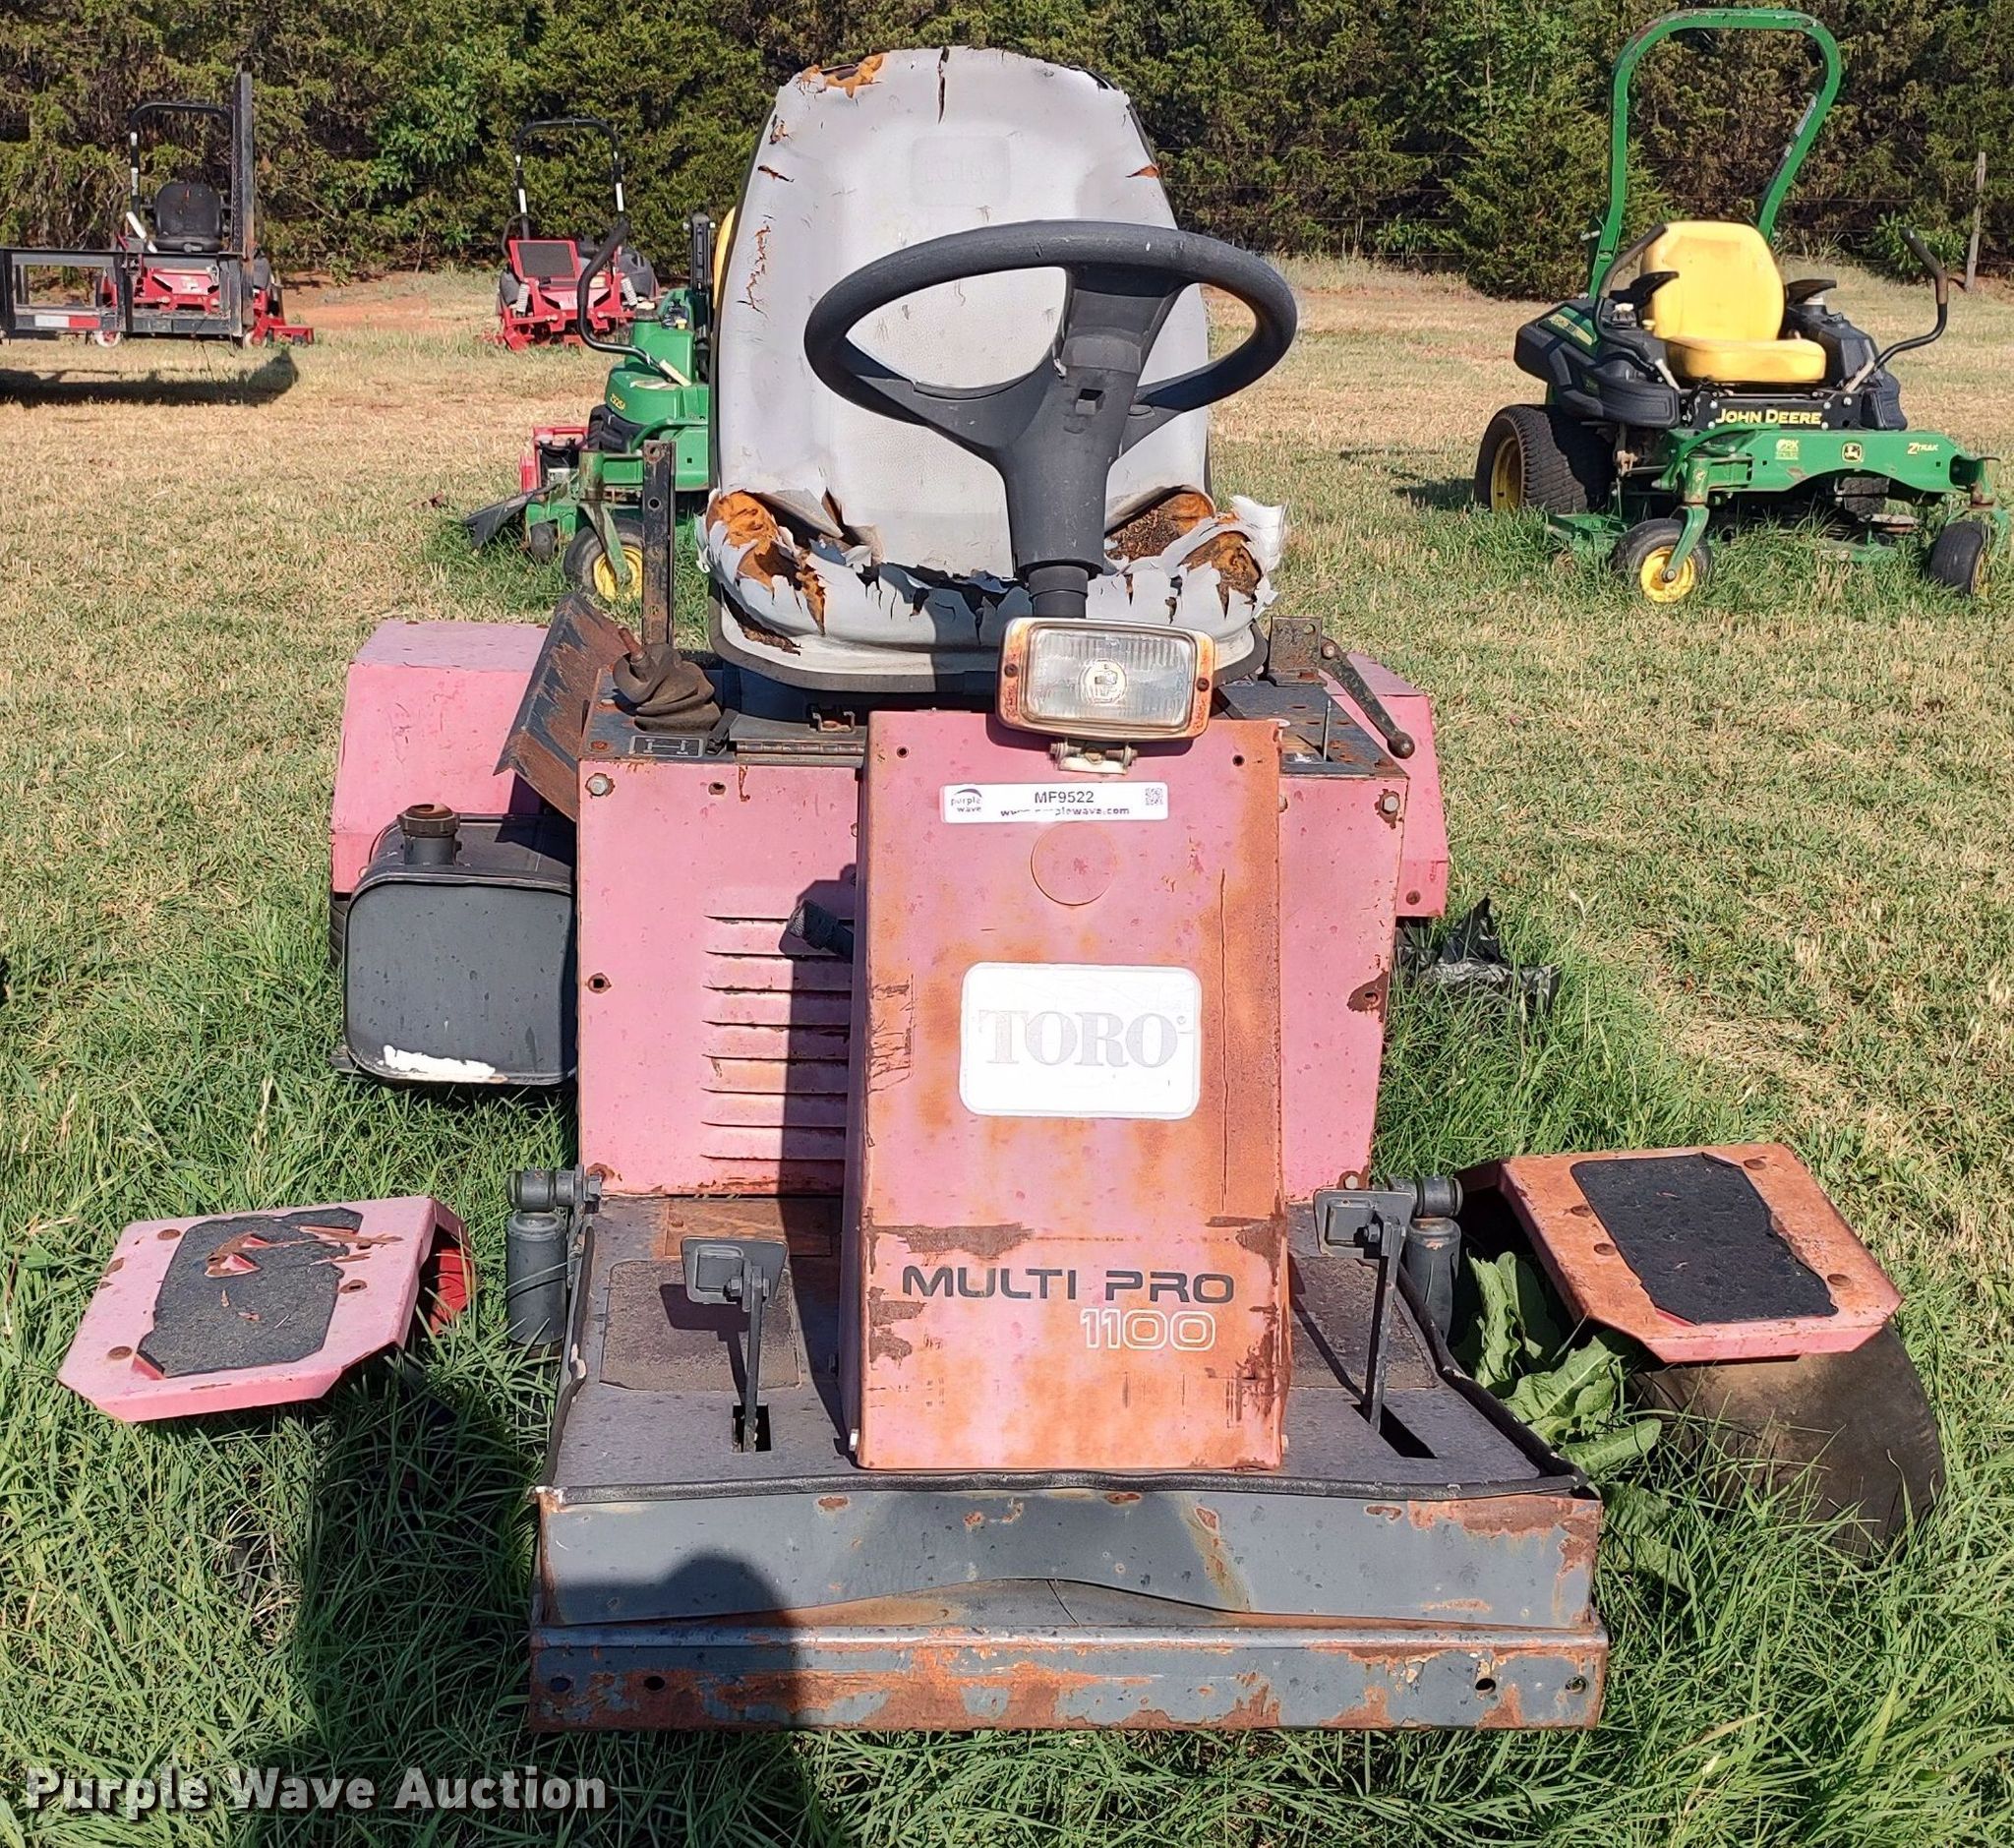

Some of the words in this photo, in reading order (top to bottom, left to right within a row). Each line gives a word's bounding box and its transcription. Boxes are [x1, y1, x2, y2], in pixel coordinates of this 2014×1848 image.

[1715, 408, 1762, 424] JOHN
[1764, 408, 1822, 425] DEERE
[1034, 791, 1095, 804] MF9522
[978, 1009, 1178, 1068] TORO
[902, 1265, 1077, 1300] MULTI
[1104, 1270, 1234, 1304] PRO
[1080, 1308, 1216, 1351] 1100
